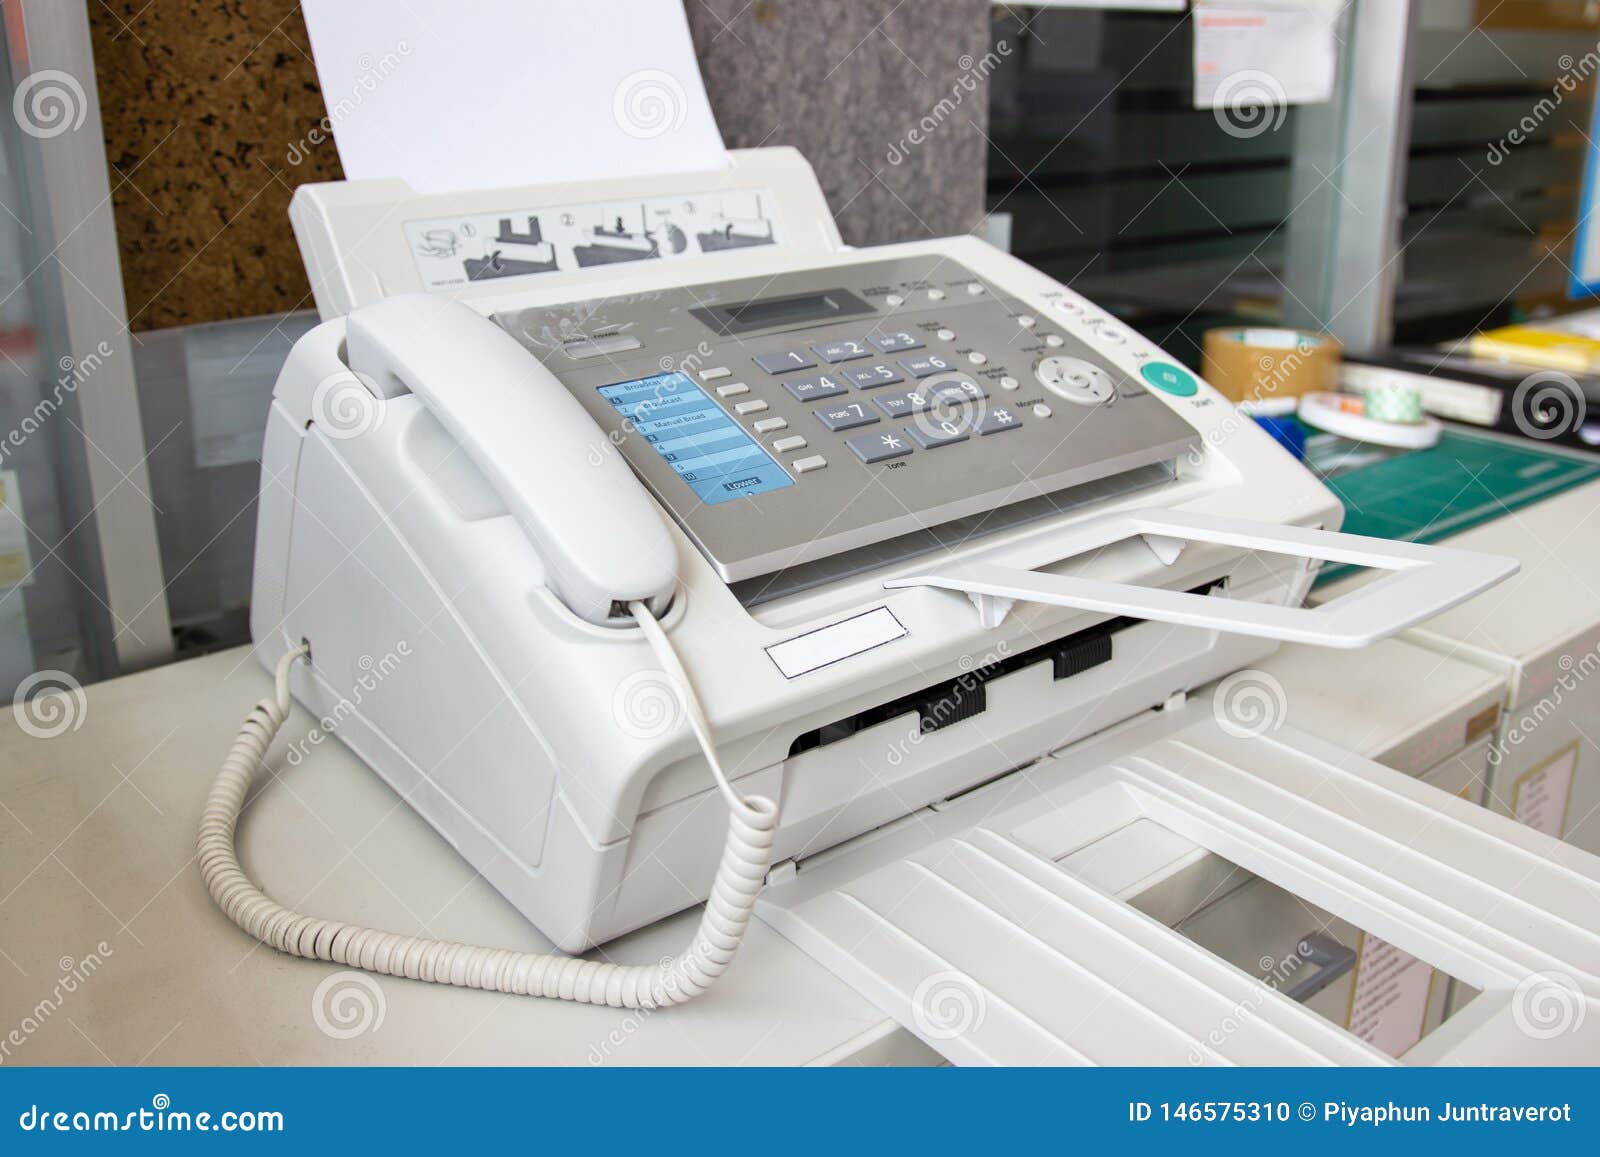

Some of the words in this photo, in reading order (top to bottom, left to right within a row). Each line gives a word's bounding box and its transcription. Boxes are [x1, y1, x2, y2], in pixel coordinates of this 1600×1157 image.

[897, 332, 916, 345] 3
[844, 341, 864, 354] 2
[788, 351, 804, 364] 1
[928, 356, 947, 369] 6
[874, 365, 894, 379] 5
[819, 376, 836, 390] 4
[960, 381, 978, 395] 9
[906, 392, 926, 406] 8
[847, 404, 864, 418] 7
[993, 408, 1013, 424] #
[885, 460, 907, 471] Tone
[726, 477, 760, 492] Lower
